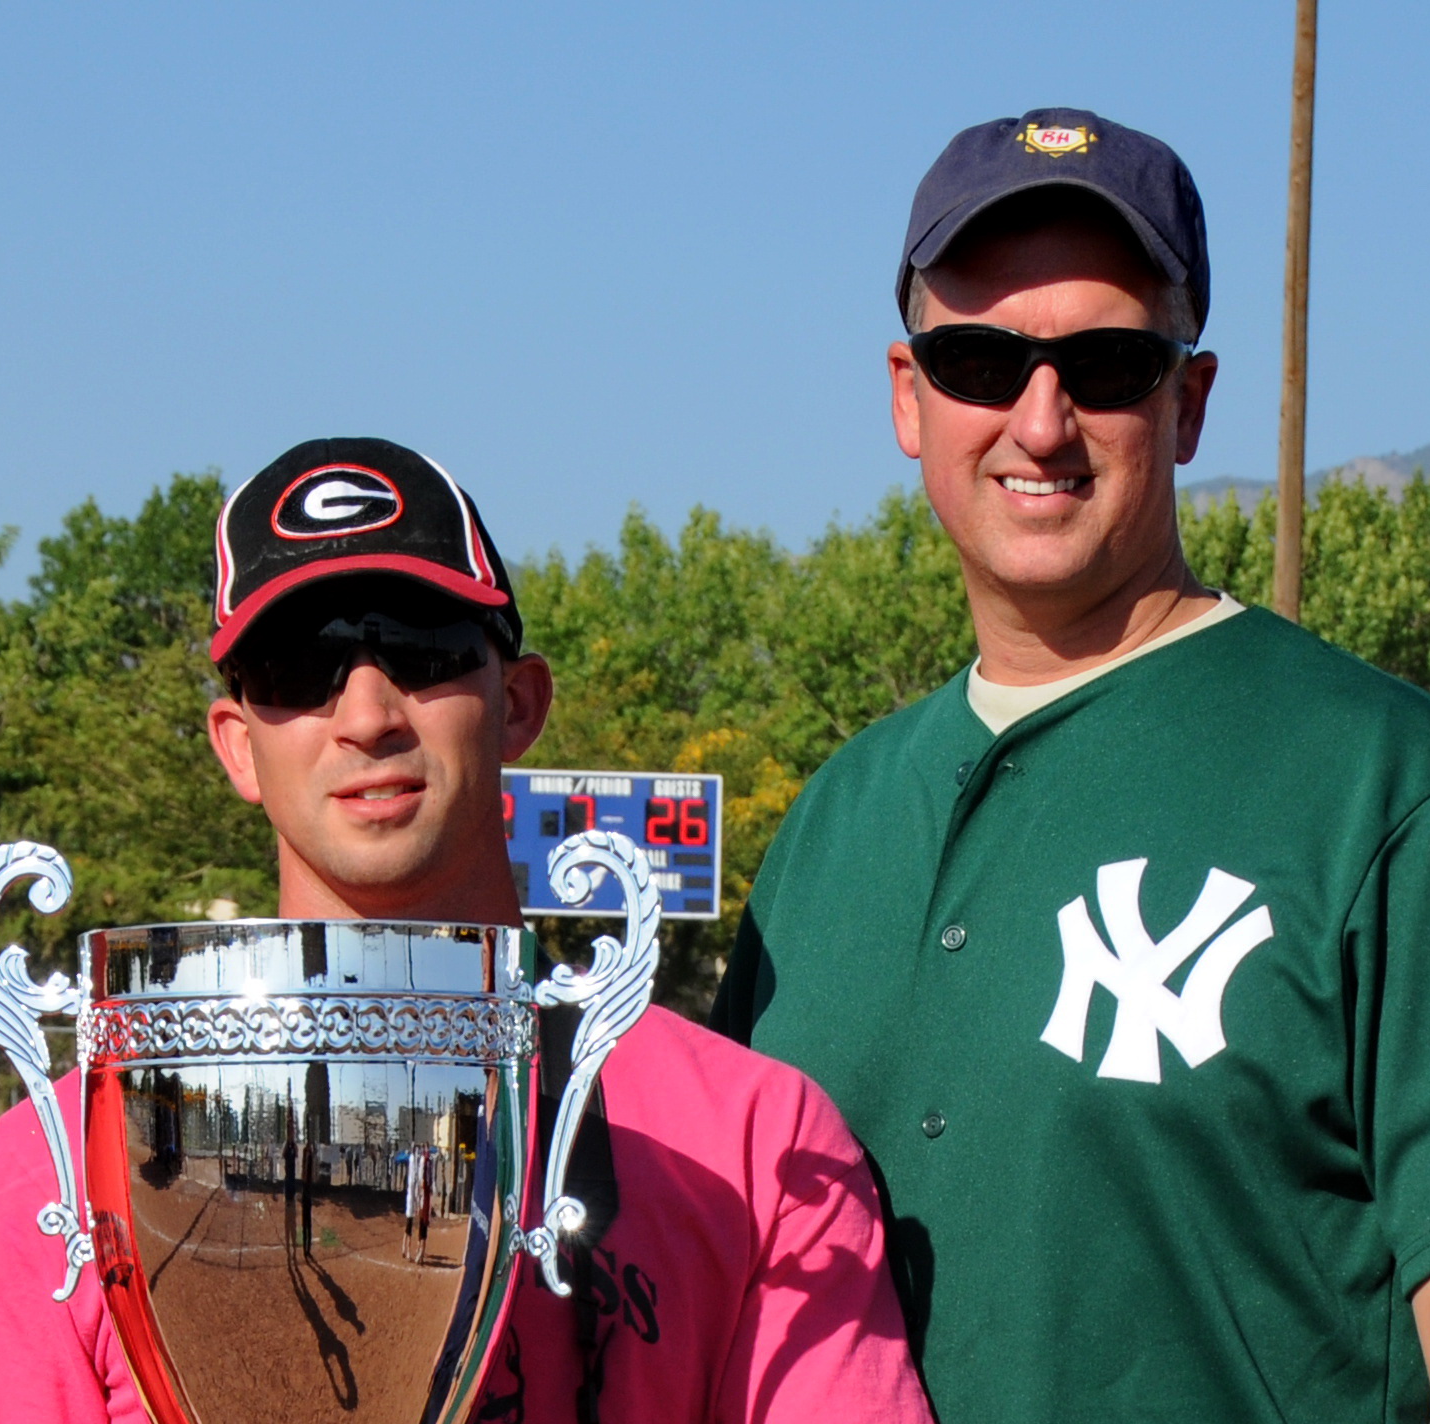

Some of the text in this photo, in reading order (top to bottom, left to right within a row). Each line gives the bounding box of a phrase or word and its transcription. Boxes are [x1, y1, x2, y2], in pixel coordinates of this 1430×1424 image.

[303, 480, 395, 520] G
[653, 779, 703, 798] GUESTS
[646, 796, 708, 846] 26
[1038, 856, 1274, 1084] NY
